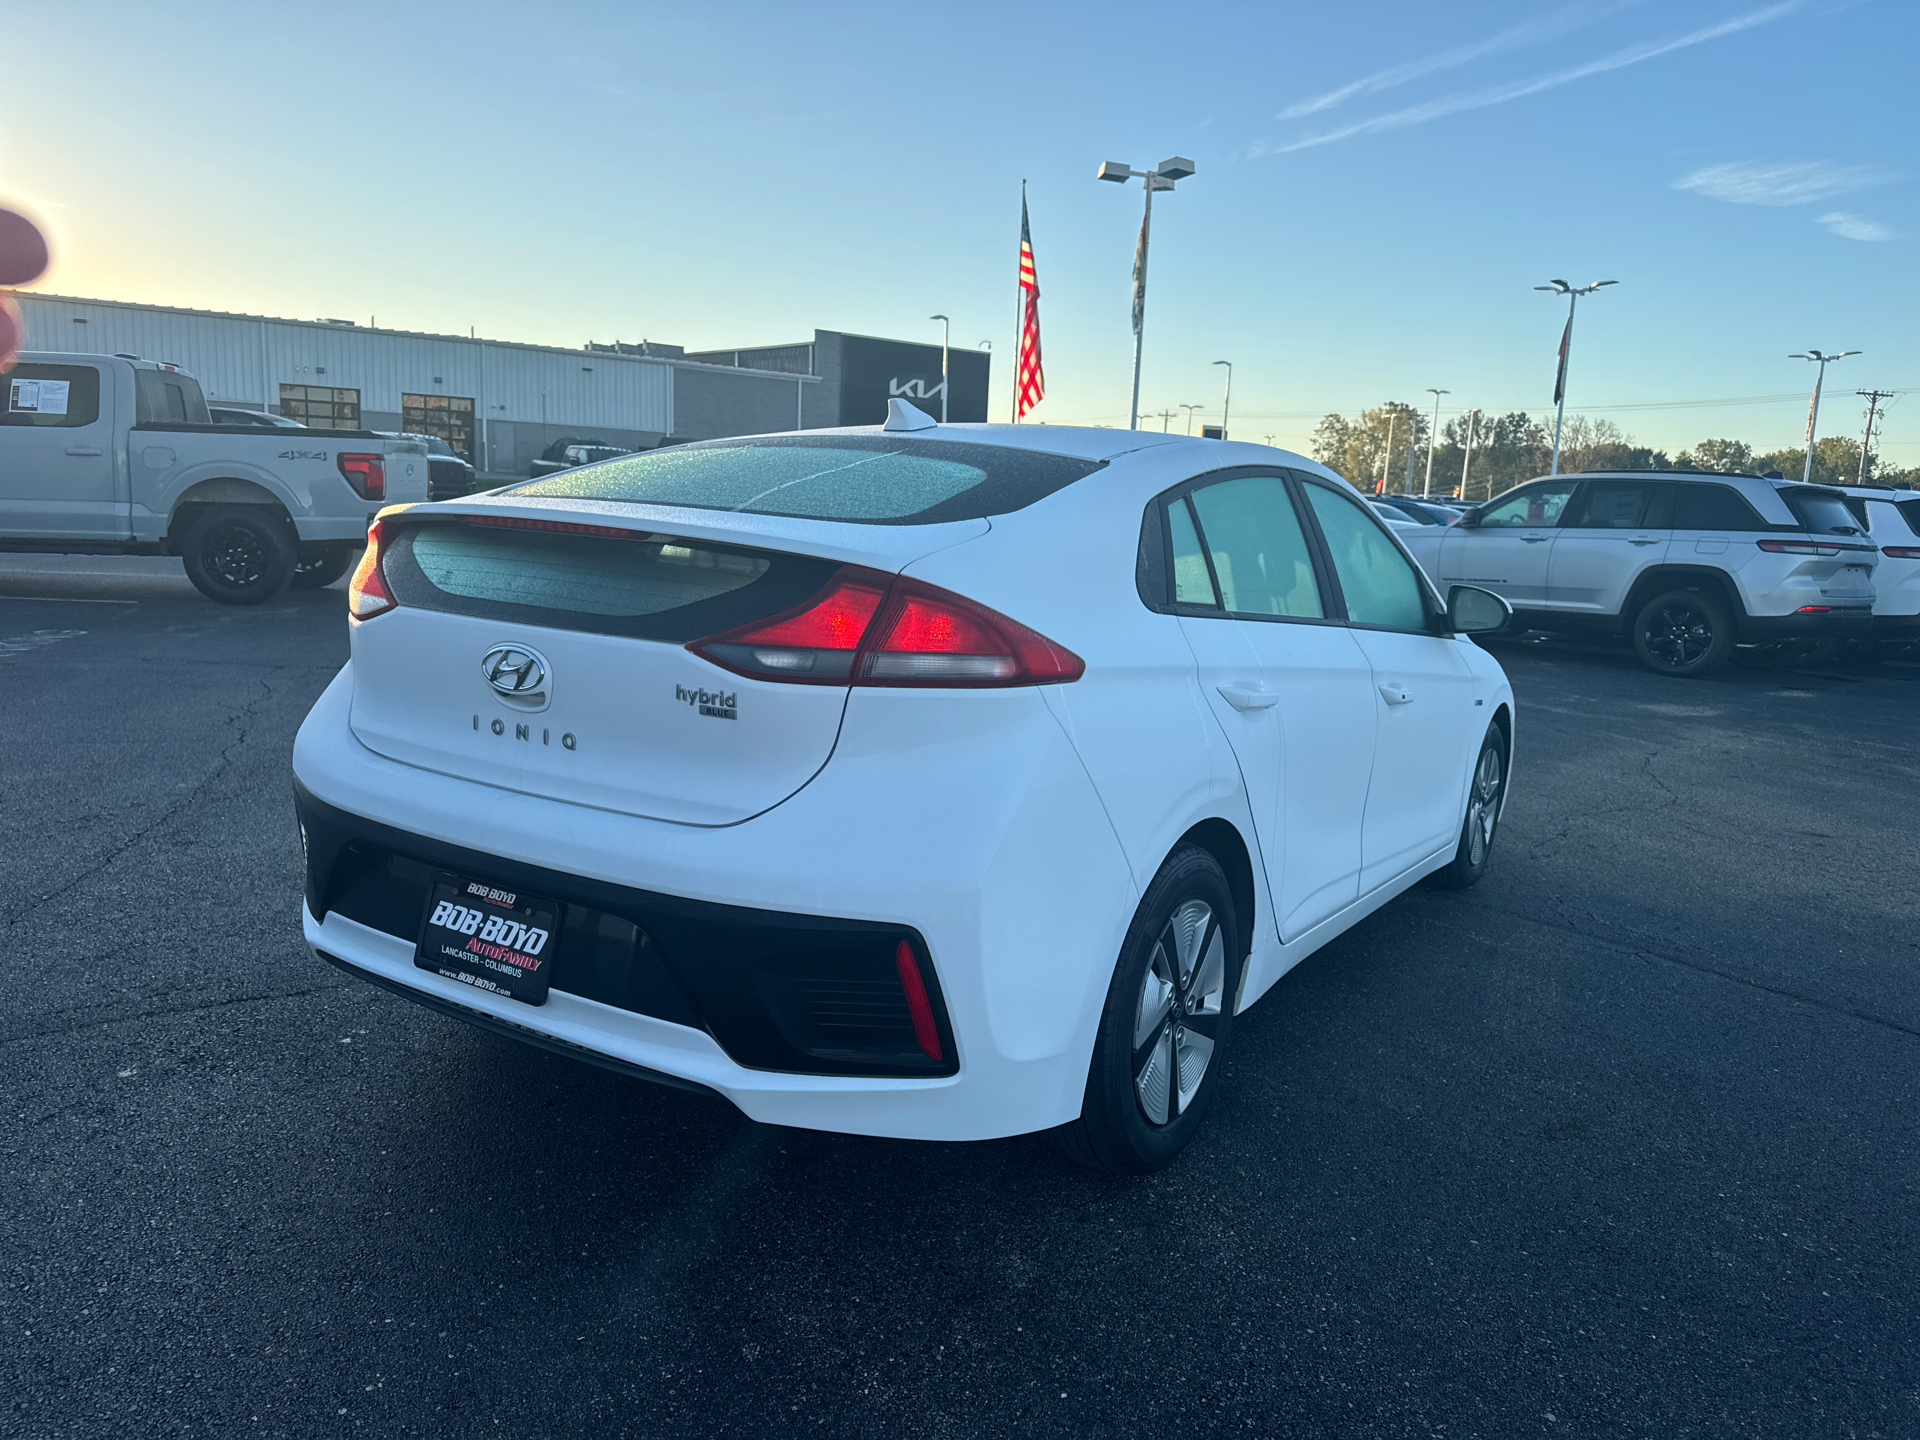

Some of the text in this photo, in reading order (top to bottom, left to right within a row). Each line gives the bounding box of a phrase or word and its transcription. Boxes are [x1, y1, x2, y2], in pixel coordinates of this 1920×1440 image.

[676, 684, 738, 708] hybrid
[706, 707, 730, 718] BLUE
[473, 714, 577, 751] IONIQ
[441, 944, 479, 964] LANCASTER
[485, 958, 522, 978] COLUMBUS
